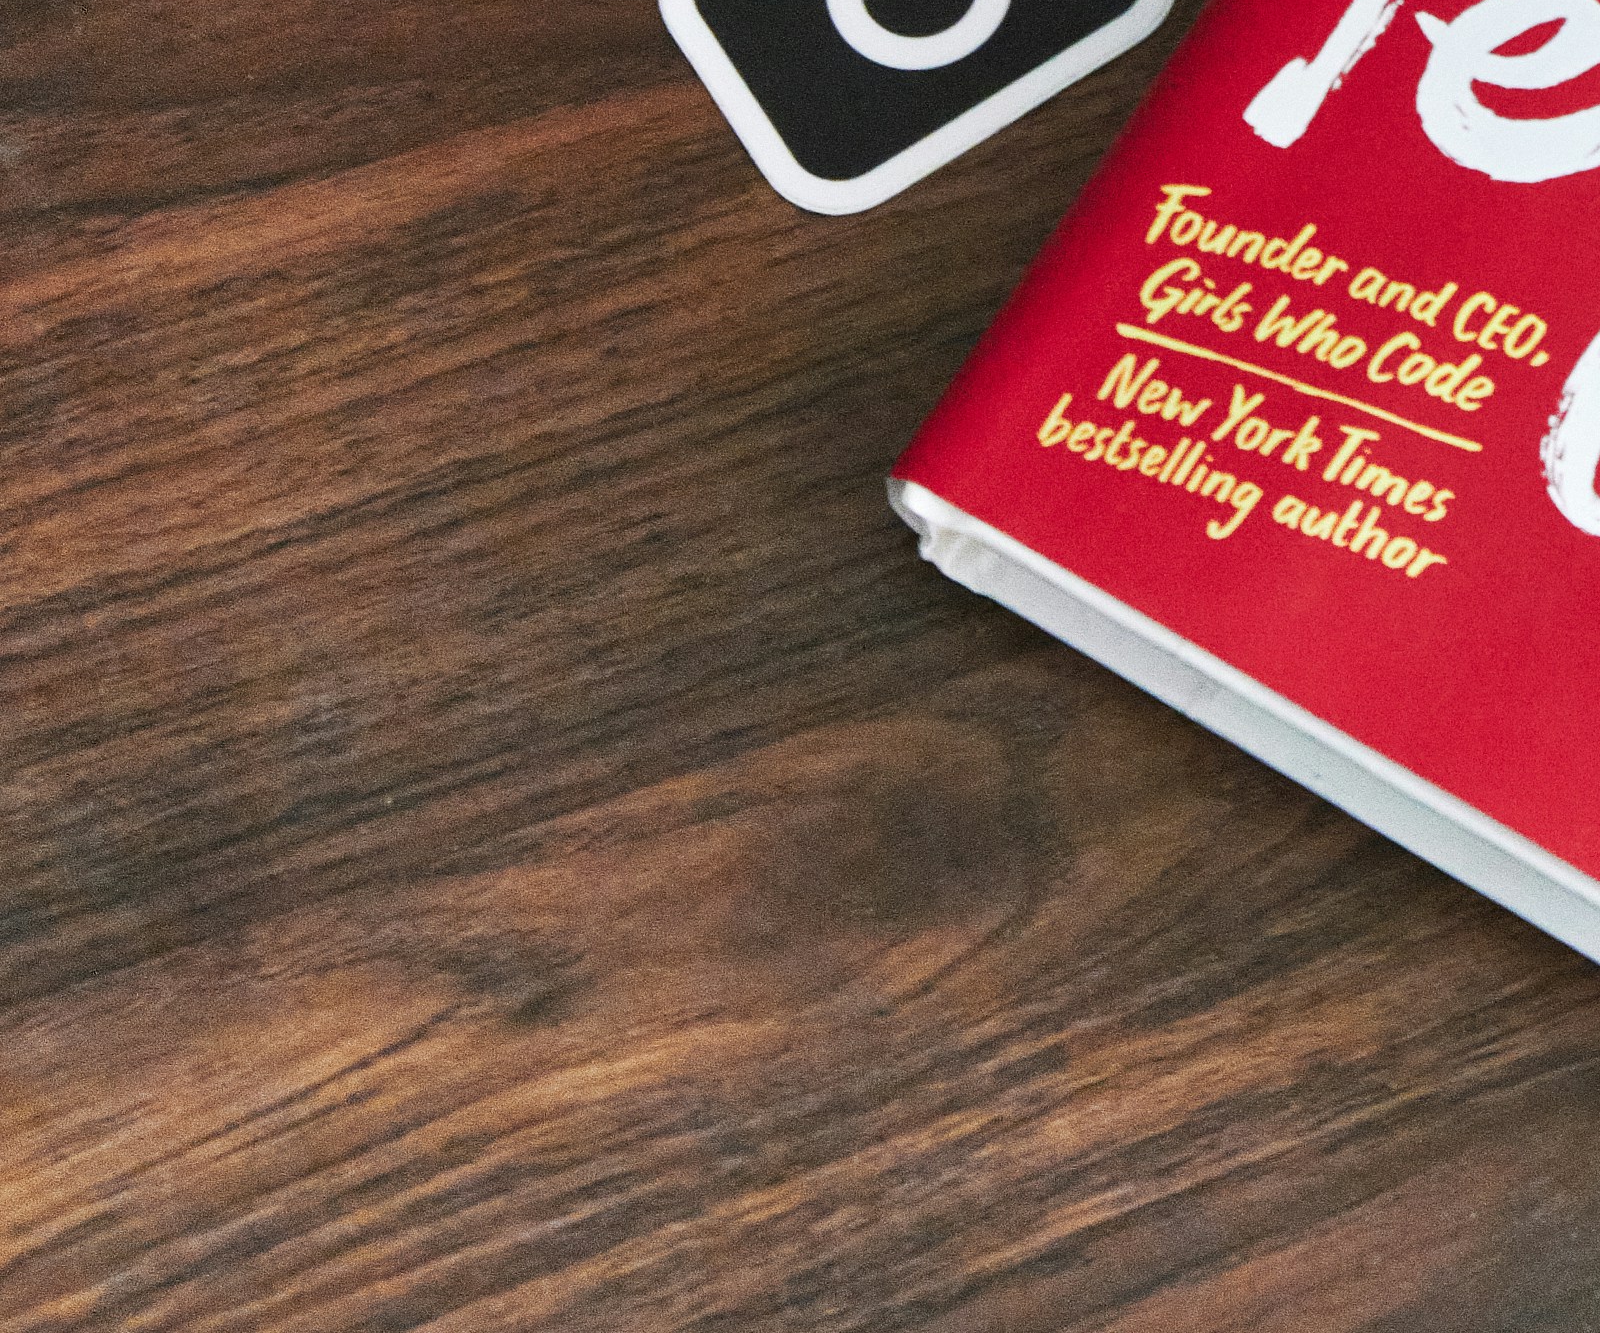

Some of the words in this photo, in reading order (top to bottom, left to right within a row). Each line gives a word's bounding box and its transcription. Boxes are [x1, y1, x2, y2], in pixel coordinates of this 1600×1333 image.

[1140, 257, 1254, 333] Girls
[1254, 295, 1367, 369] Who
[1366, 332, 1496, 412] Code
[1145, 184, 1349, 285] Founder
[1348, 267, 1458, 328] and
[1453, 291, 1550, 367] CEO,
[1036, 393, 1265, 540] bestselling
[1272, 493, 1448, 579] author
[1097, 353, 1213, 426] New
[1211, 383, 1325, 471] York
[1323, 424, 1456, 523] Times
